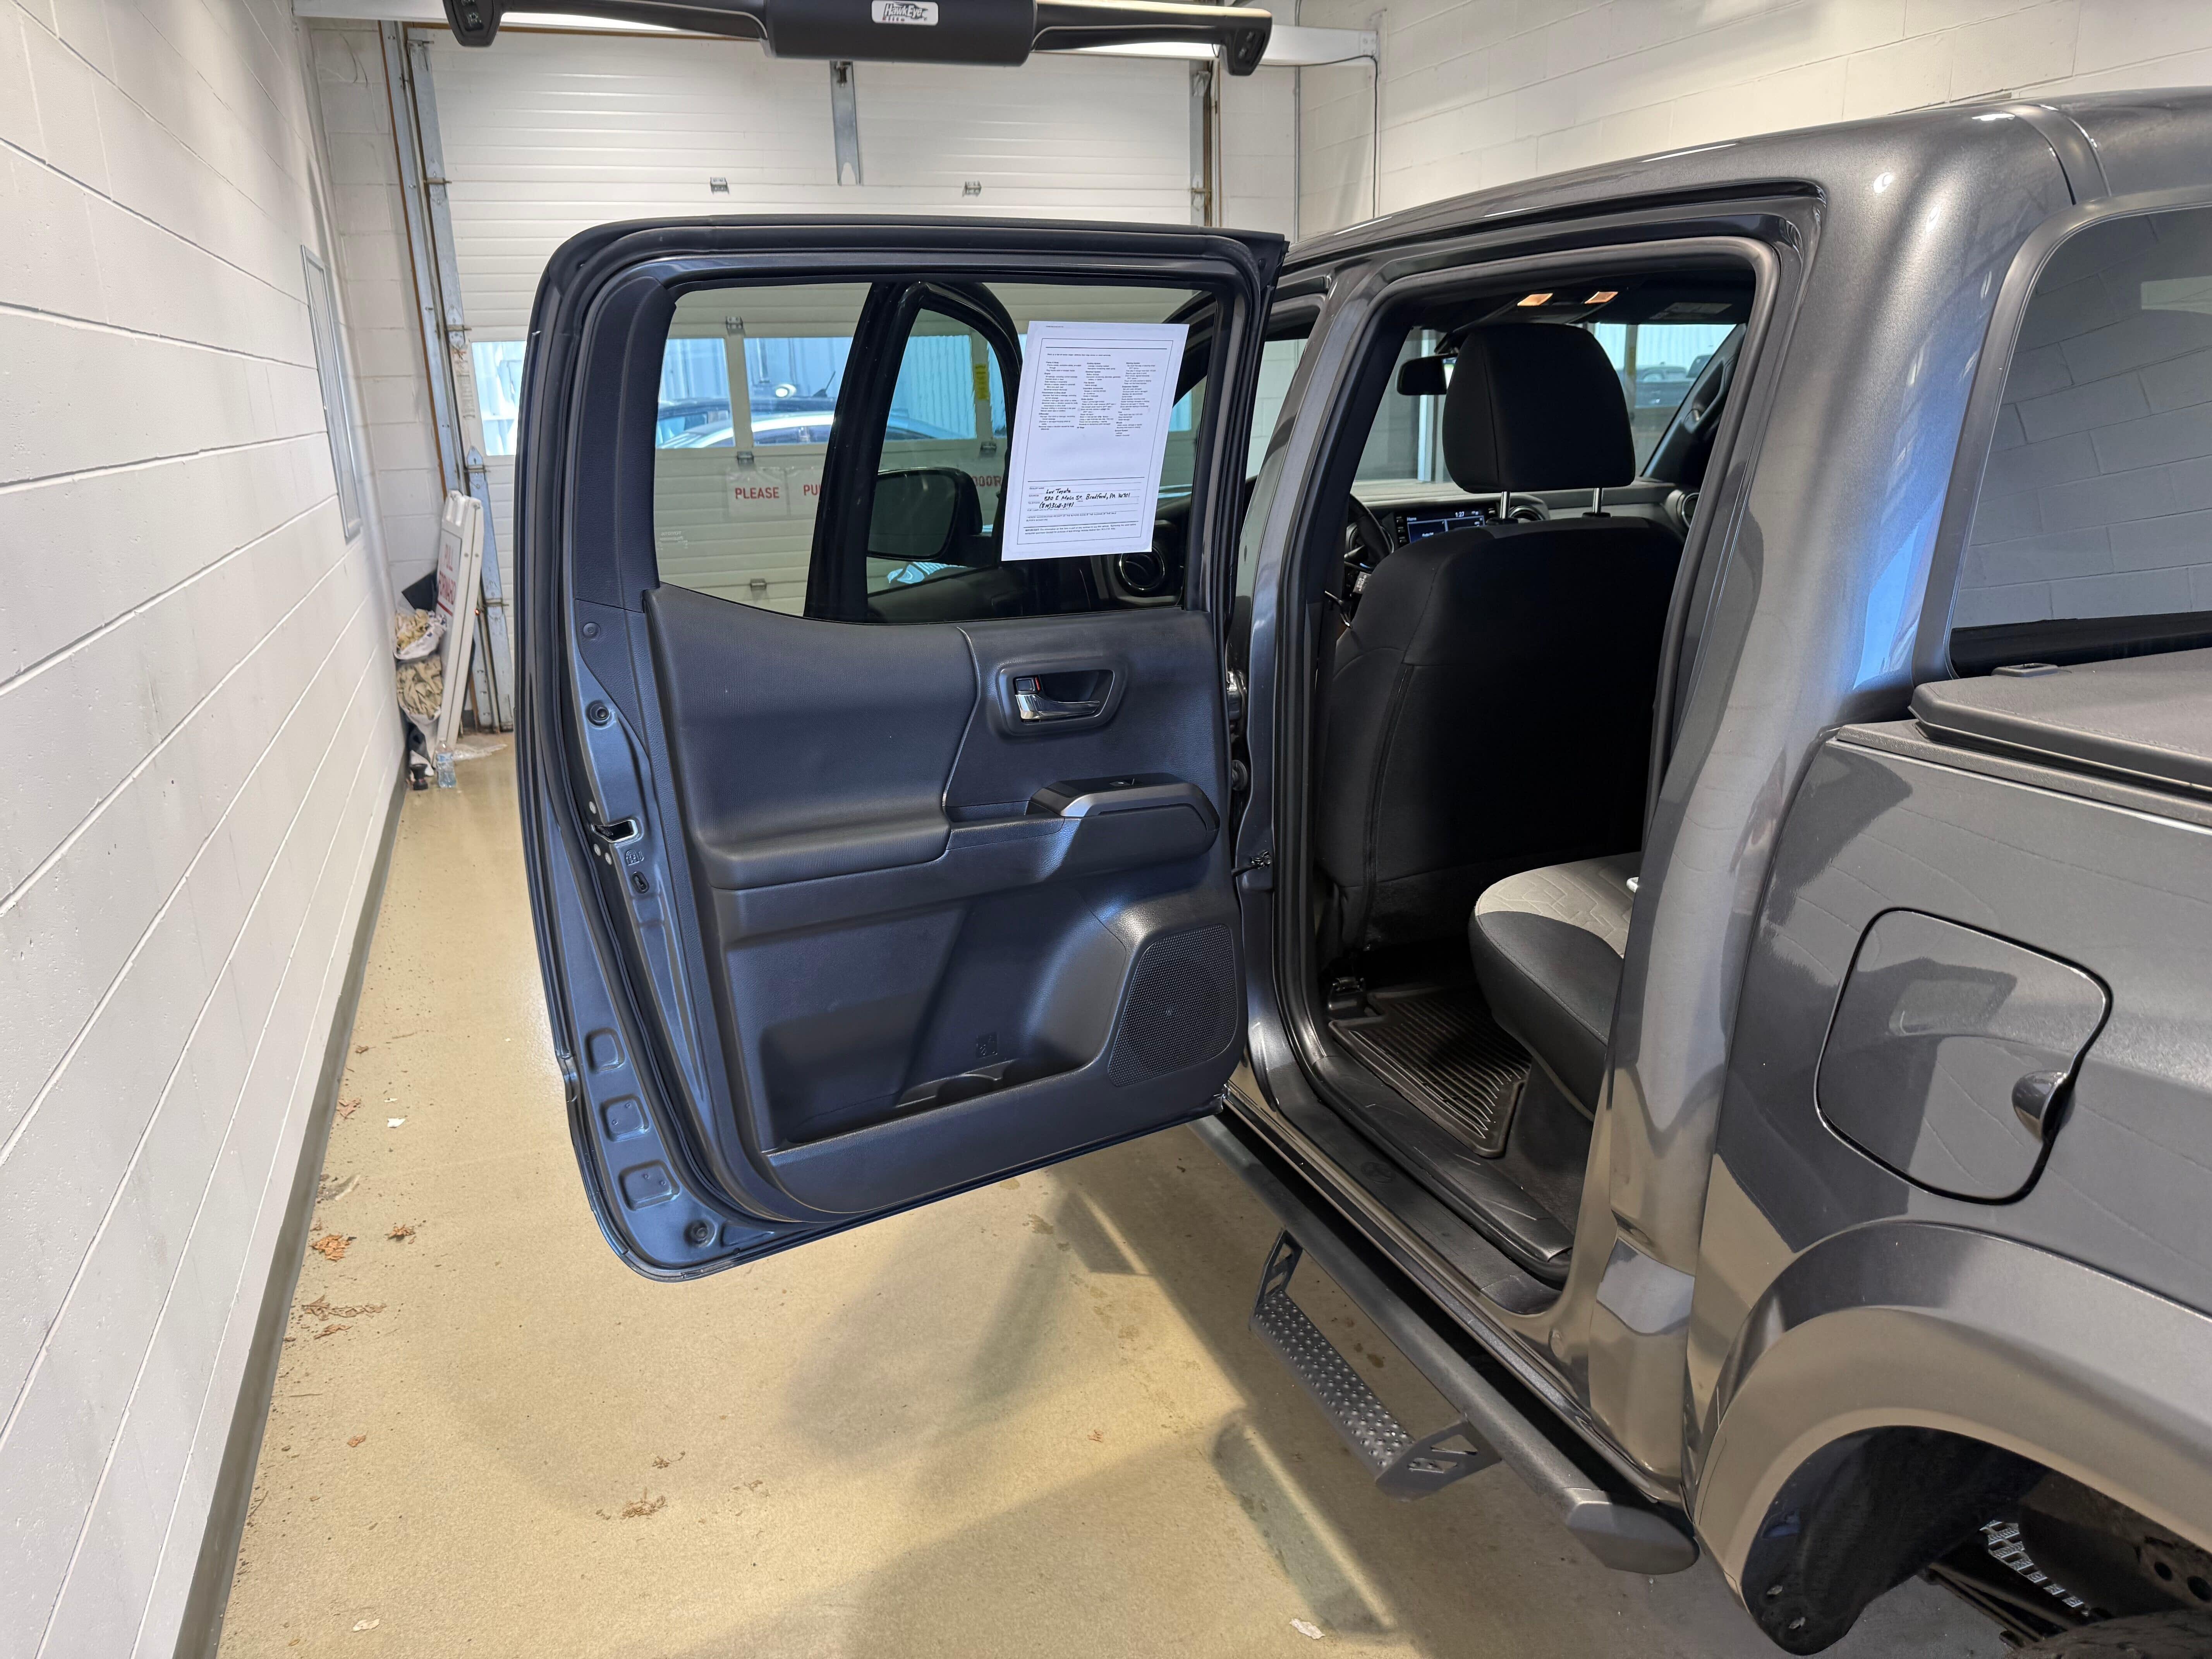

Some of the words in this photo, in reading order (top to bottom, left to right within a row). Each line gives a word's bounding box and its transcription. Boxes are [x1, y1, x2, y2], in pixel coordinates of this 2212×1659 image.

[884, 3, 923, 19] HawkEye
[735, 487, 780, 499] PLEASE
[804, 484, 821, 496] PU
